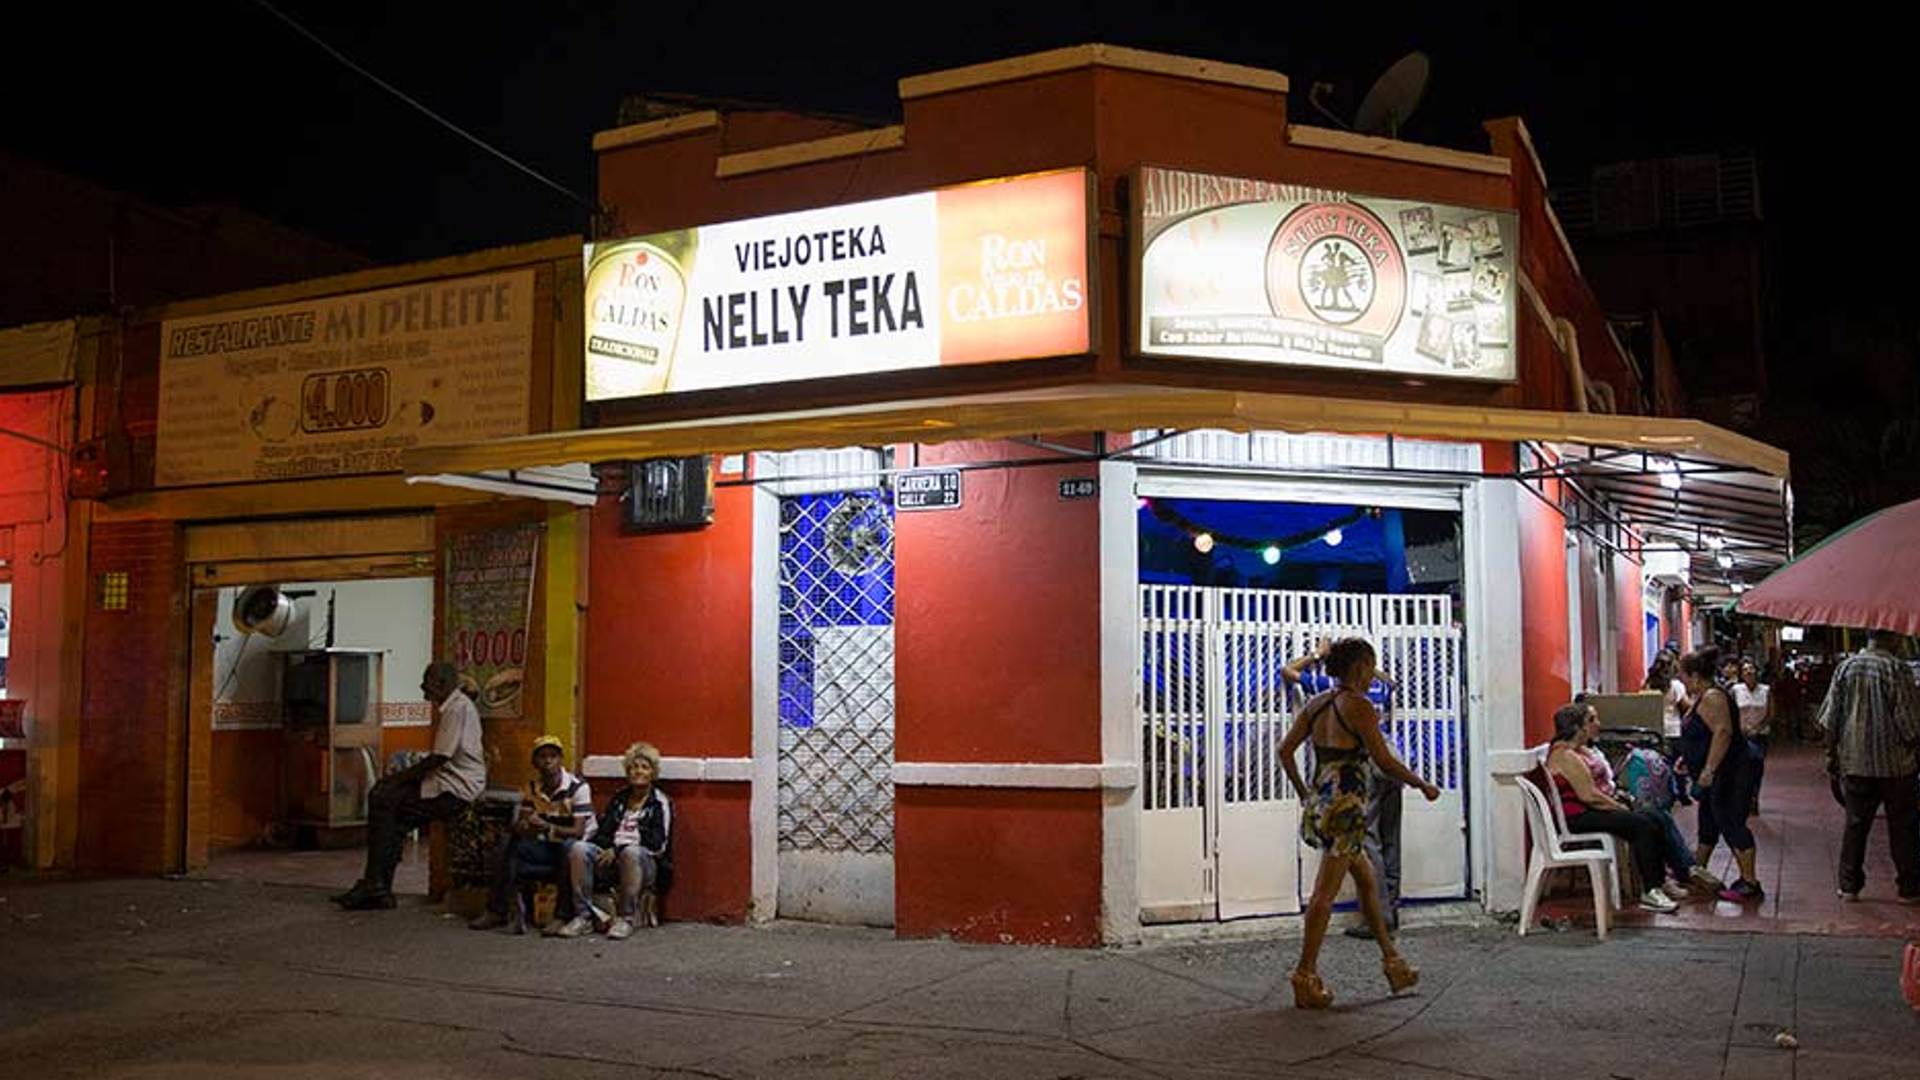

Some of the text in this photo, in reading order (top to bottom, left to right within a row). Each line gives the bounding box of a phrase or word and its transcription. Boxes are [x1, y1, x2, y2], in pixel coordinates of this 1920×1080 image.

[1143, 167, 1250, 217] AMBIENTE
[736, 225, 886, 272] VIEJOTEKA
[977, 234, 1046, 270] RON
[1284, 213, 1390, 268] NELLY TEKA
[618, 262, 661, 293] RON
[947, 279, 1083, 322] CALDAS
[326, 303, 367, 343] MI
[379, 282, 512, 334] DELEITE
[590, 294, 669, 334] CALDAS
[703, 270, 925, 353] NELLY TEKA
